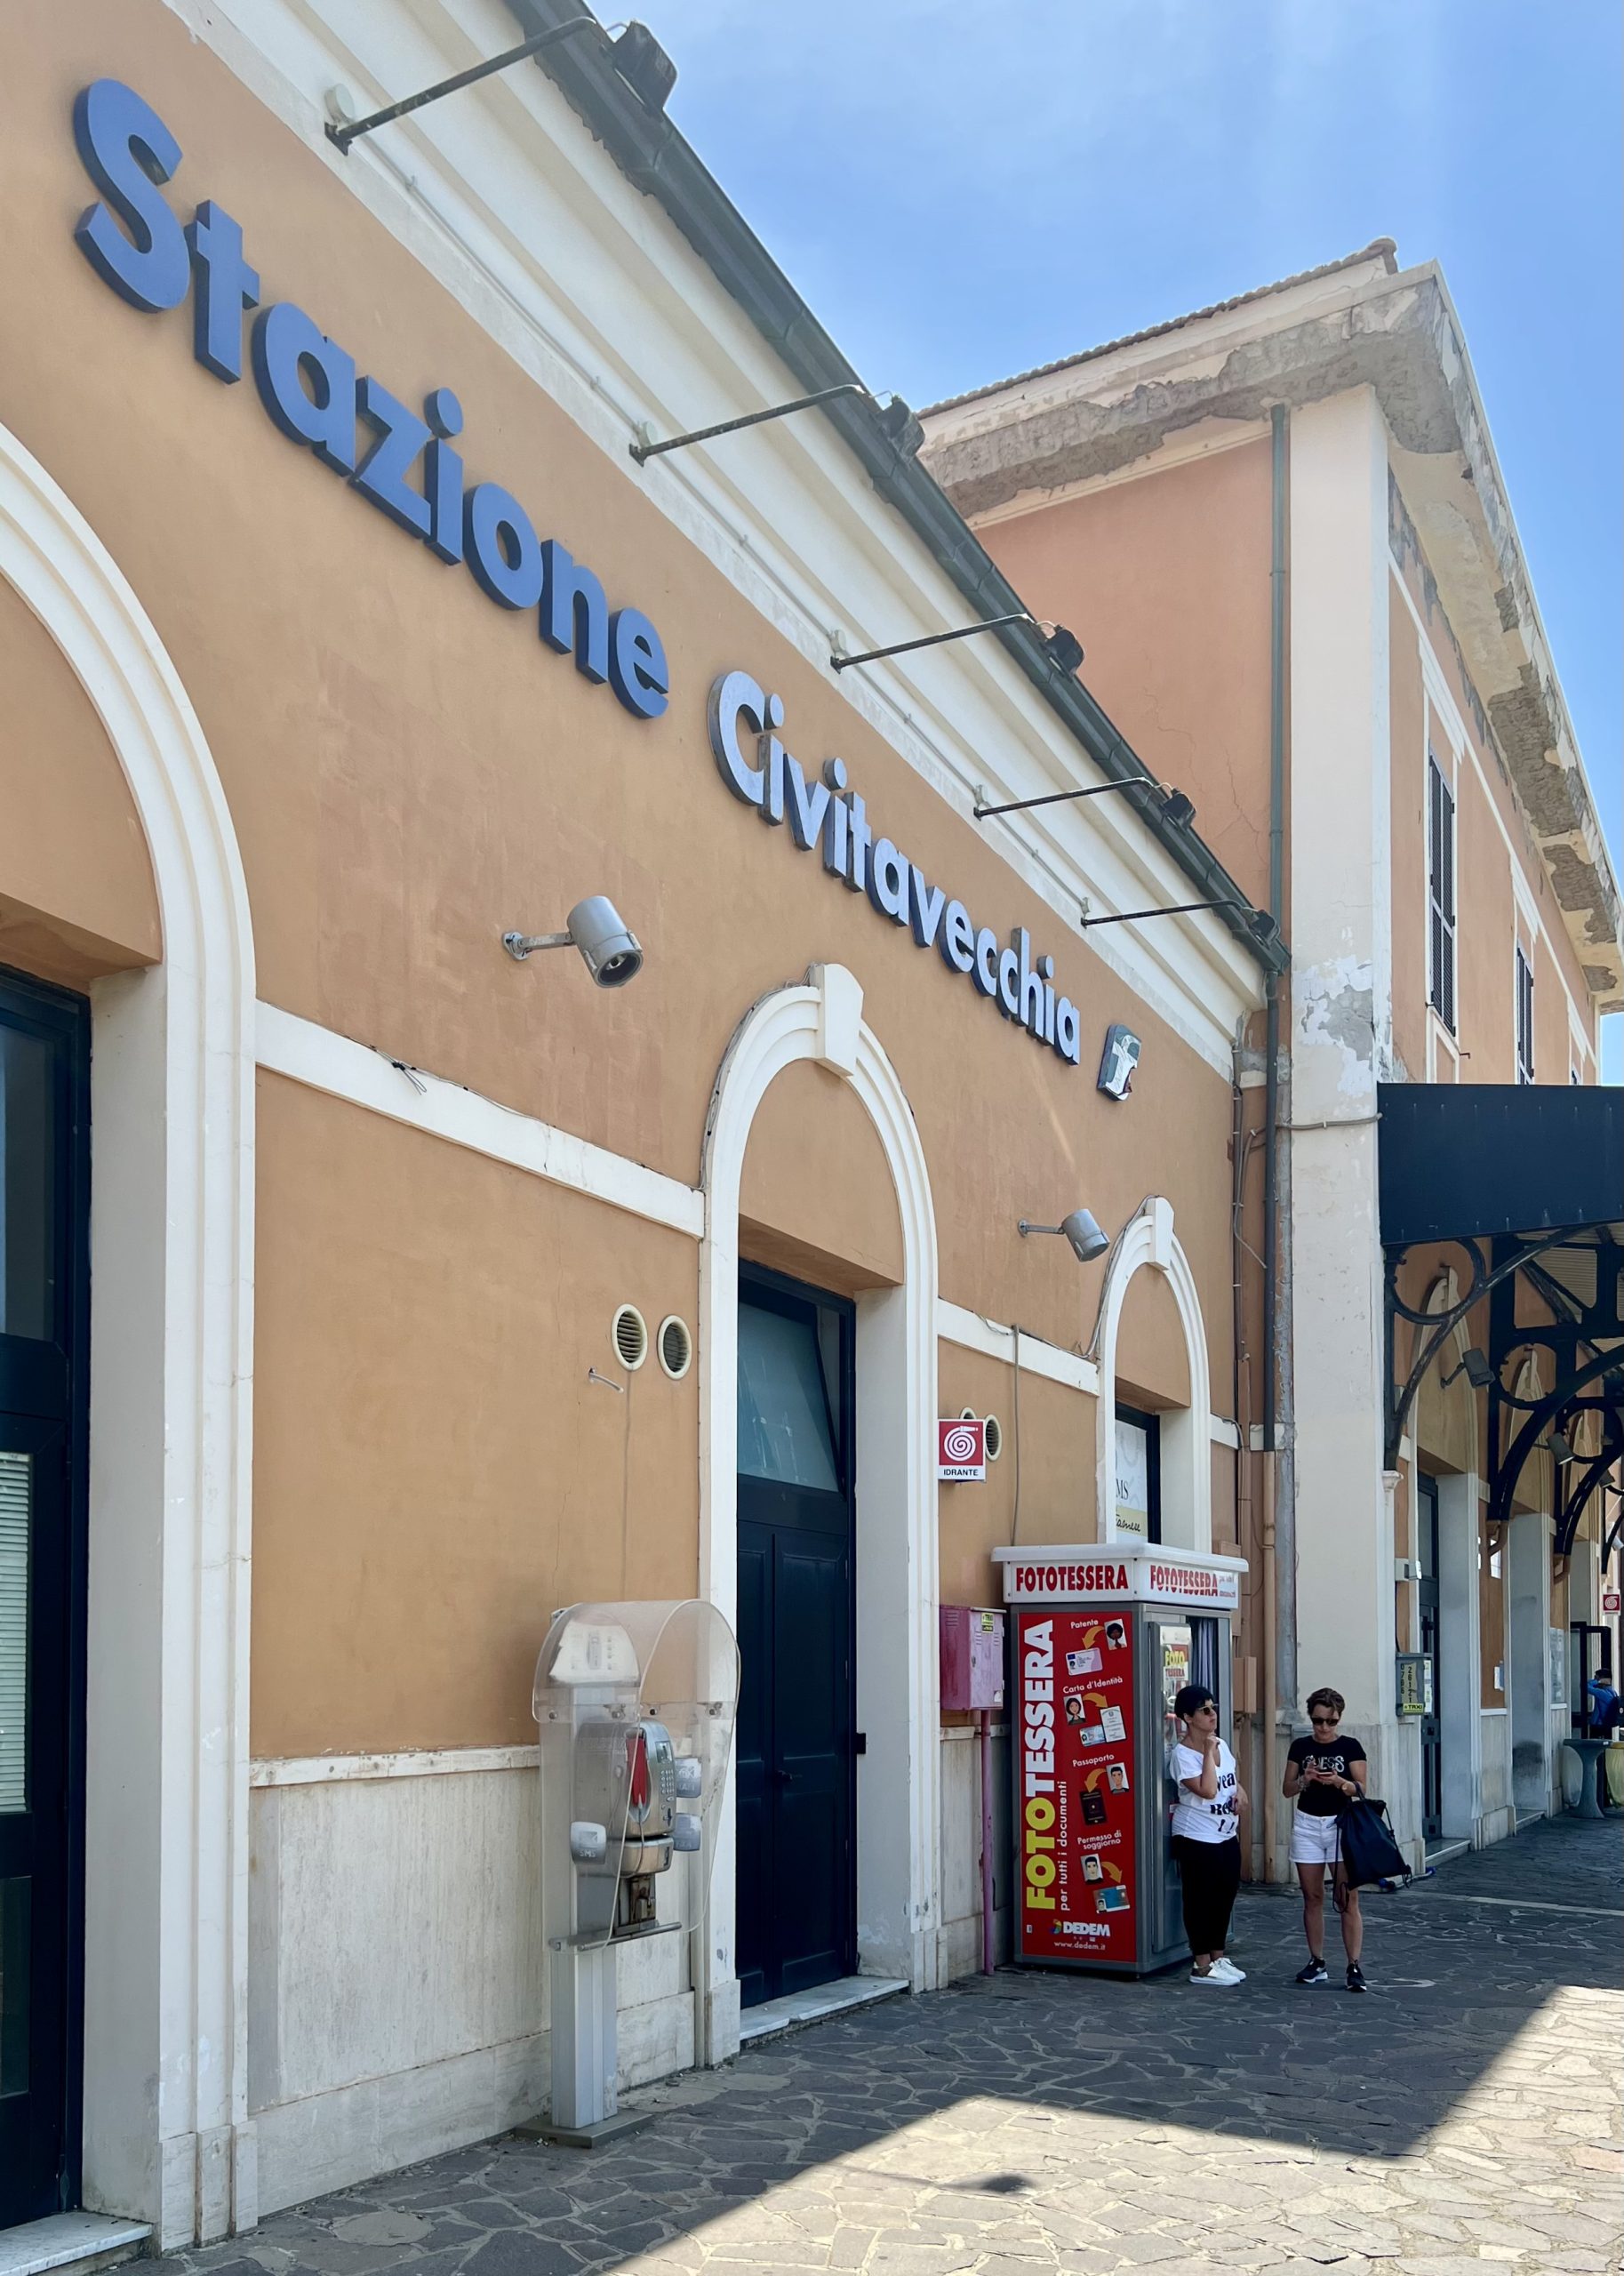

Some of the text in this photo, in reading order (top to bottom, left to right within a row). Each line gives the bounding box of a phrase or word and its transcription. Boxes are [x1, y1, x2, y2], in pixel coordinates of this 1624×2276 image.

[74, 78, 1081, 1065] Stazione Civitavecchia
[943, 1468, 979, 1477] IDRANTE
[1016, 1565, 1129, 1592] FOTOTESSERA
[1150, 1565, 1219, 1597] FOTOTESSERA
[1070, 1619, 1099, 1629] Patente
[1164, 1651, 1185, 1666] FOTO
[1062, 1676, 1124, 1694] Carta d'Identità
[1025, 1619, 1056, 1911] FOTOTESSERA
[1072, 1754, 1115, 1767] Passaporto
[1057, 1781, 1068, 1847] documenti
[1077, 1830, 1122, 1845] Permesso di
[1084, 1838, 1121, 1850] soggiorno
[580, 1848, 596, 1858] SMS
[1057, 1861, 1068, 1885] tutti
[1060, 1889, 1070, 1911] per
[1063, 1921, 1111, 1936] DEDEM
[1053, 1941, 1106, 1951] www.dedem.it
